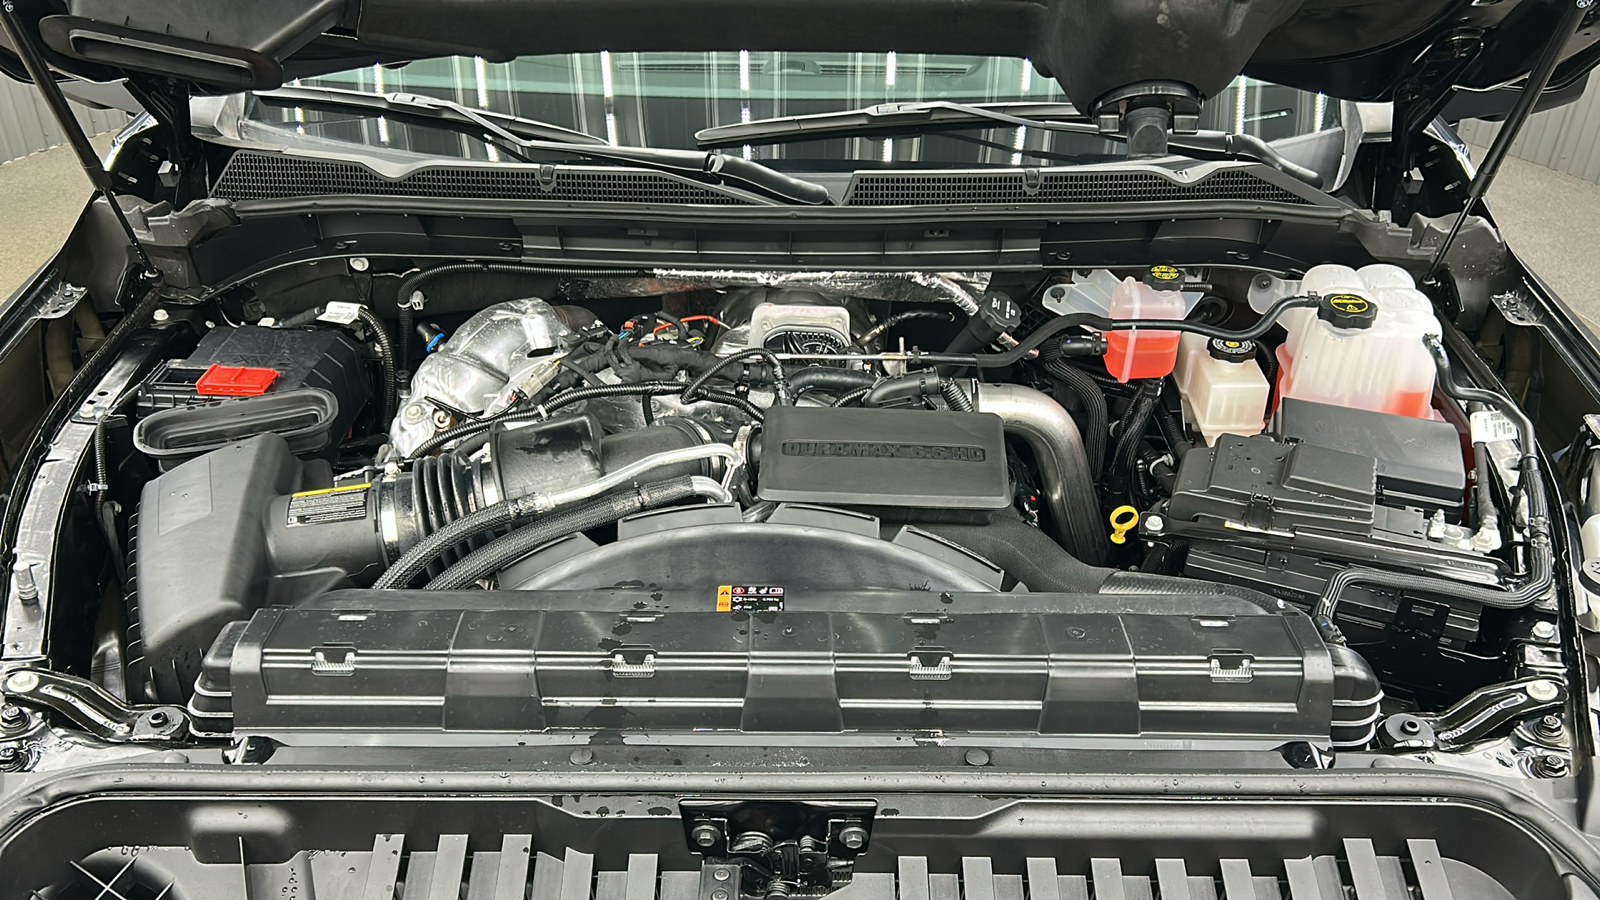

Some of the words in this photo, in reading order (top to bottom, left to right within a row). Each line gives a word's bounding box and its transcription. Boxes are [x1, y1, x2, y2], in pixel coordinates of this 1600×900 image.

[786, 443, 901, 457] DURAMAX
[910, 445, 946, 459] 6.6
[951, 446, 983, 460] HD
